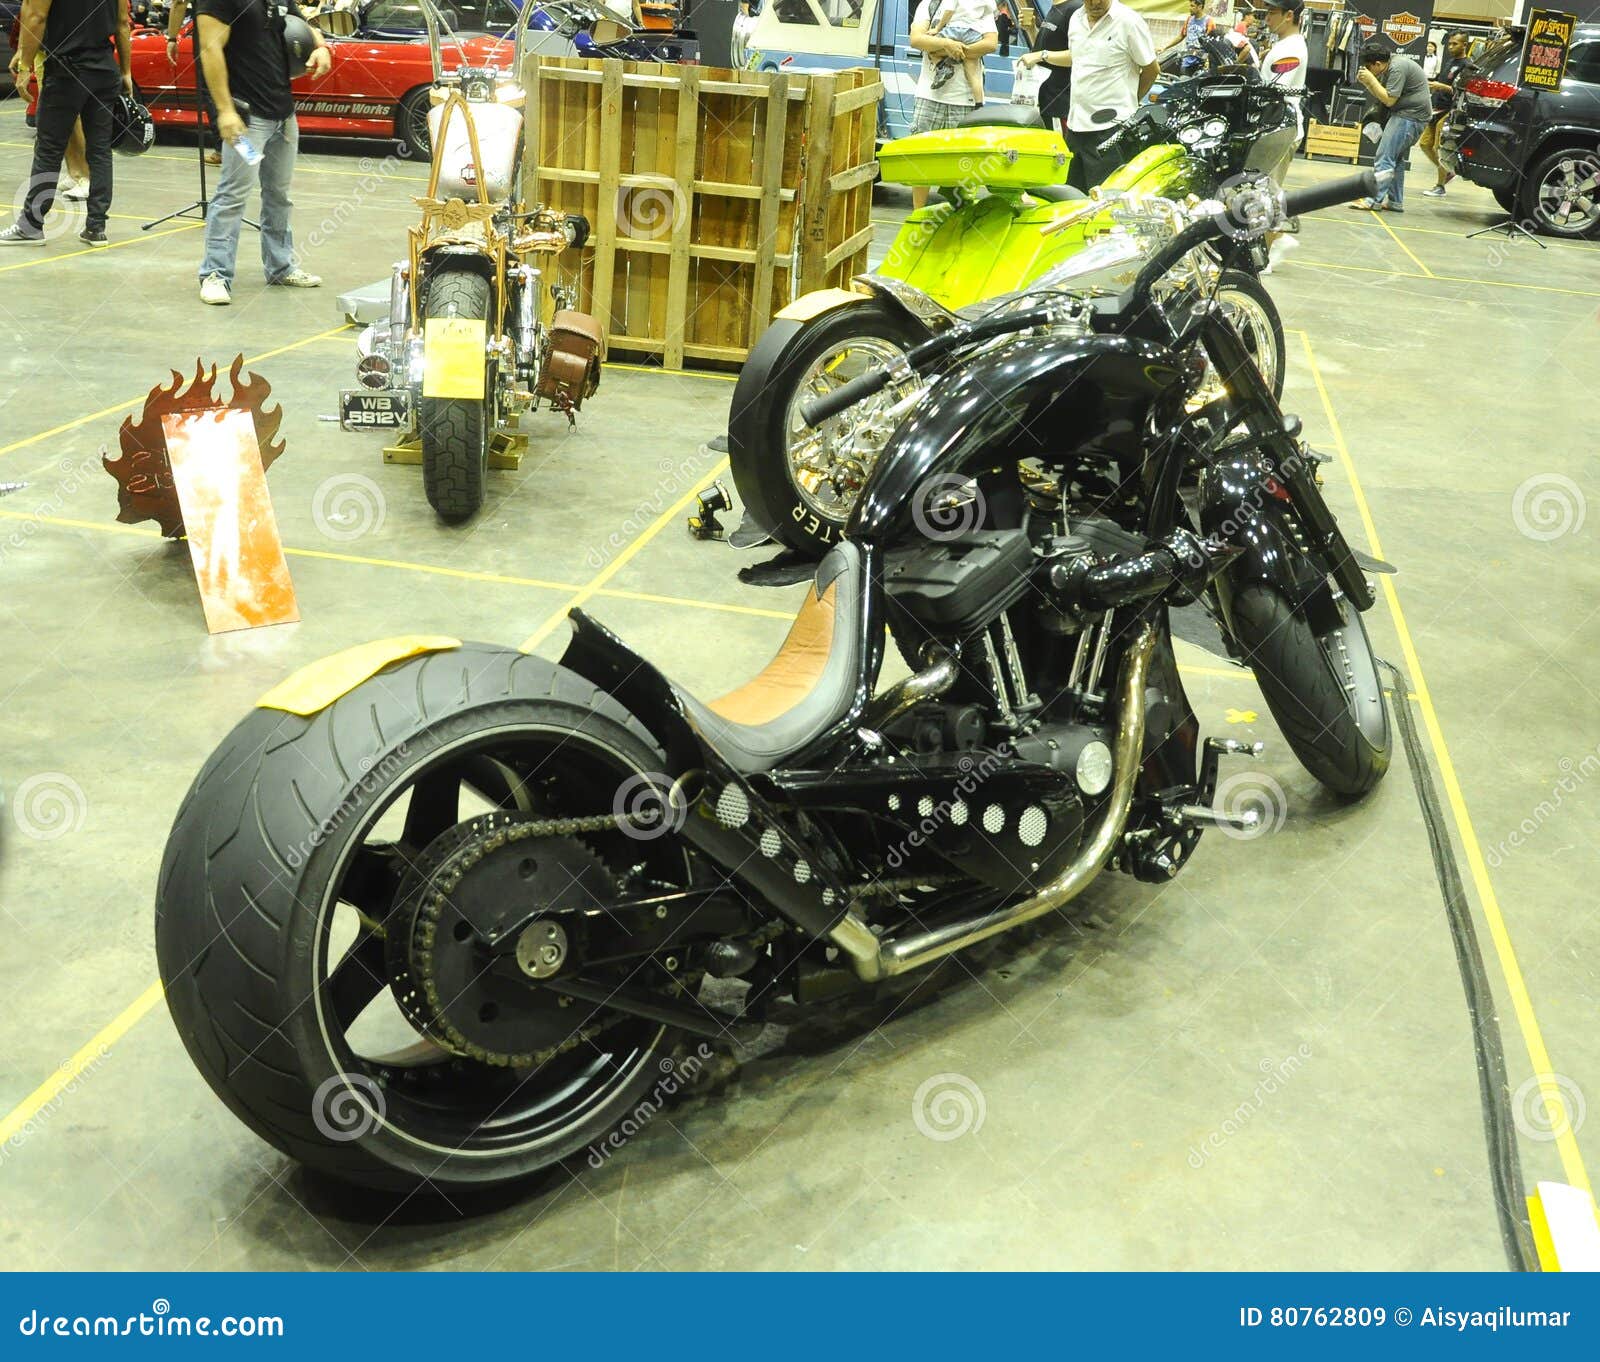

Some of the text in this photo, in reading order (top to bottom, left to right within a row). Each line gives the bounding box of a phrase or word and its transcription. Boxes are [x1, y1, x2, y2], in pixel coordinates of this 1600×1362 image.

[1525, 66, 1552, 76] DISPLAYS
[1524, 74, 1556, 86] VEHICLES
[314, 102, 351, 113] Motor
[351, 103, 391, 115] Works
[361, 397, 392, 410] WB
[348, 411, 407, 424] 5812V
